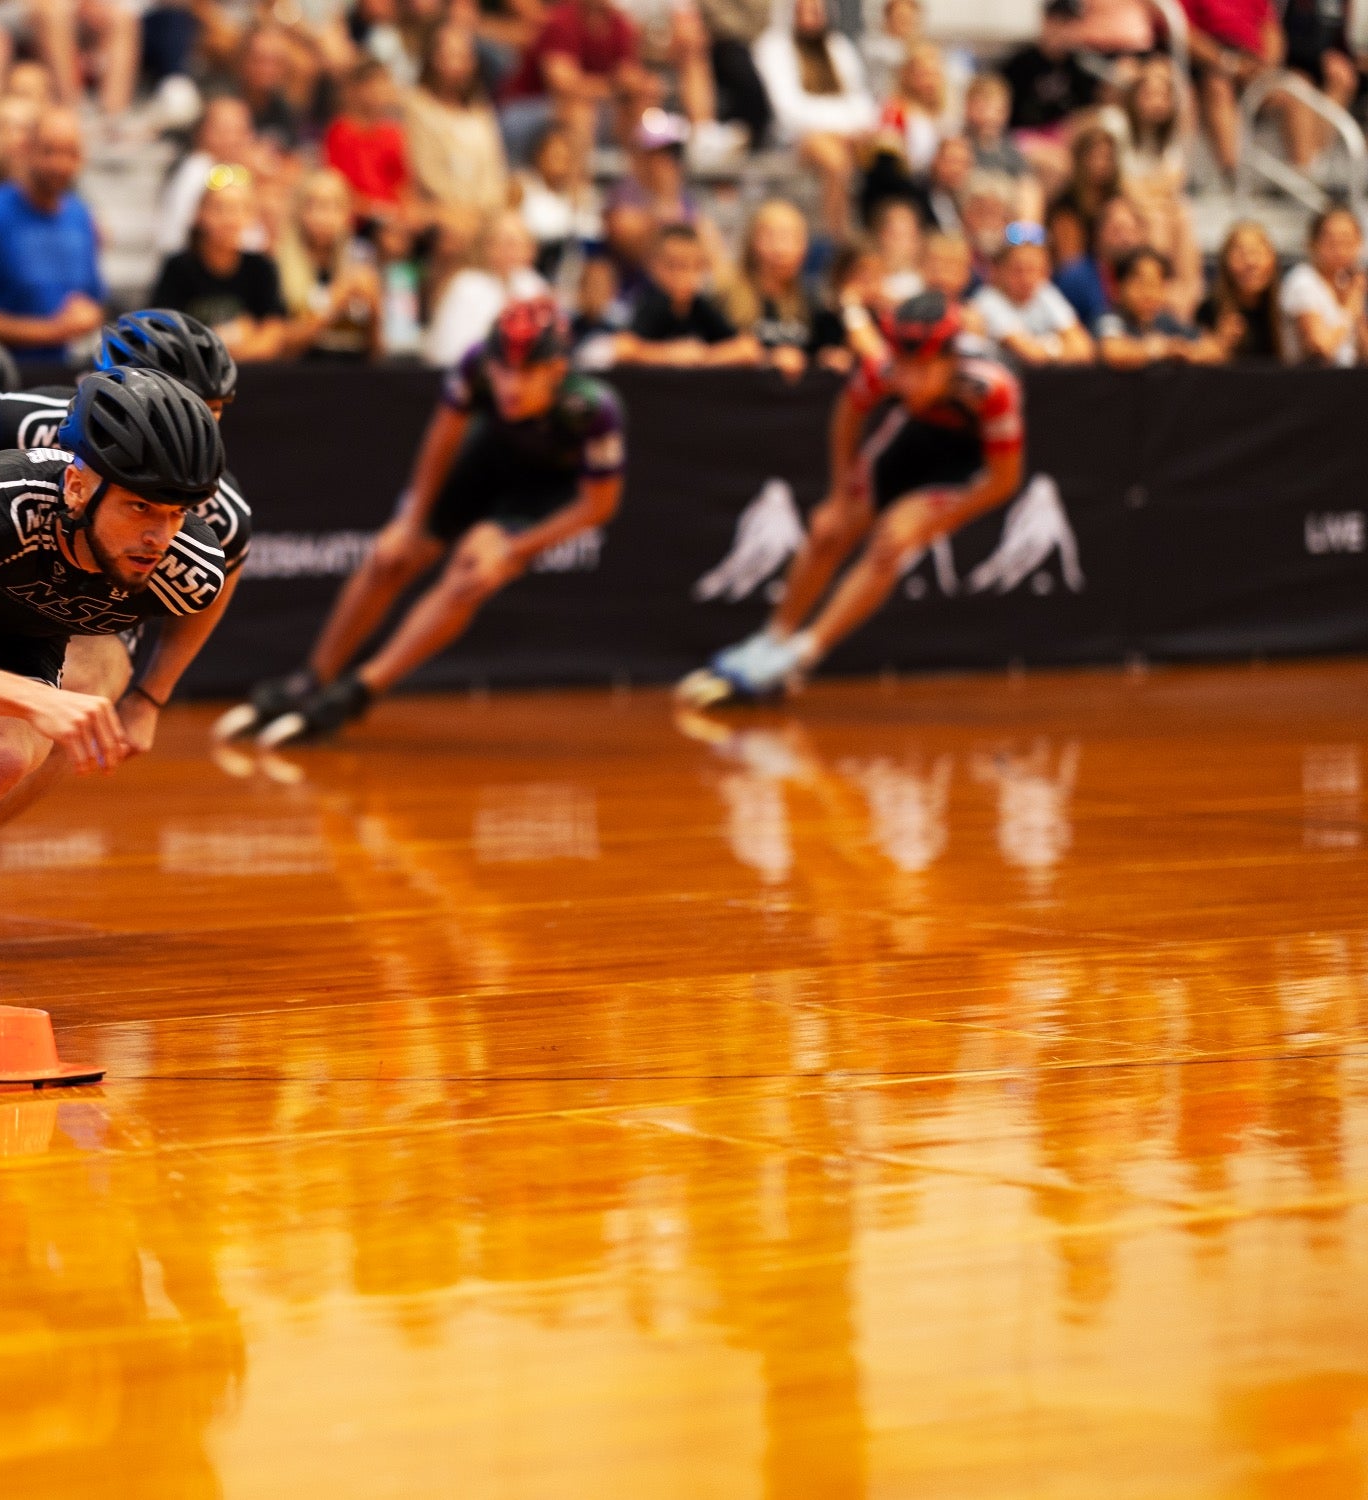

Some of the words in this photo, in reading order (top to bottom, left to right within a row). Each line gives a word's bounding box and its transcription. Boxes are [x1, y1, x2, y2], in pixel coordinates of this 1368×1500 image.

[190, 497, 227, 526] SC
[157, 553, 218, 605] NSC
[6, 580, 139, 634] NSC
